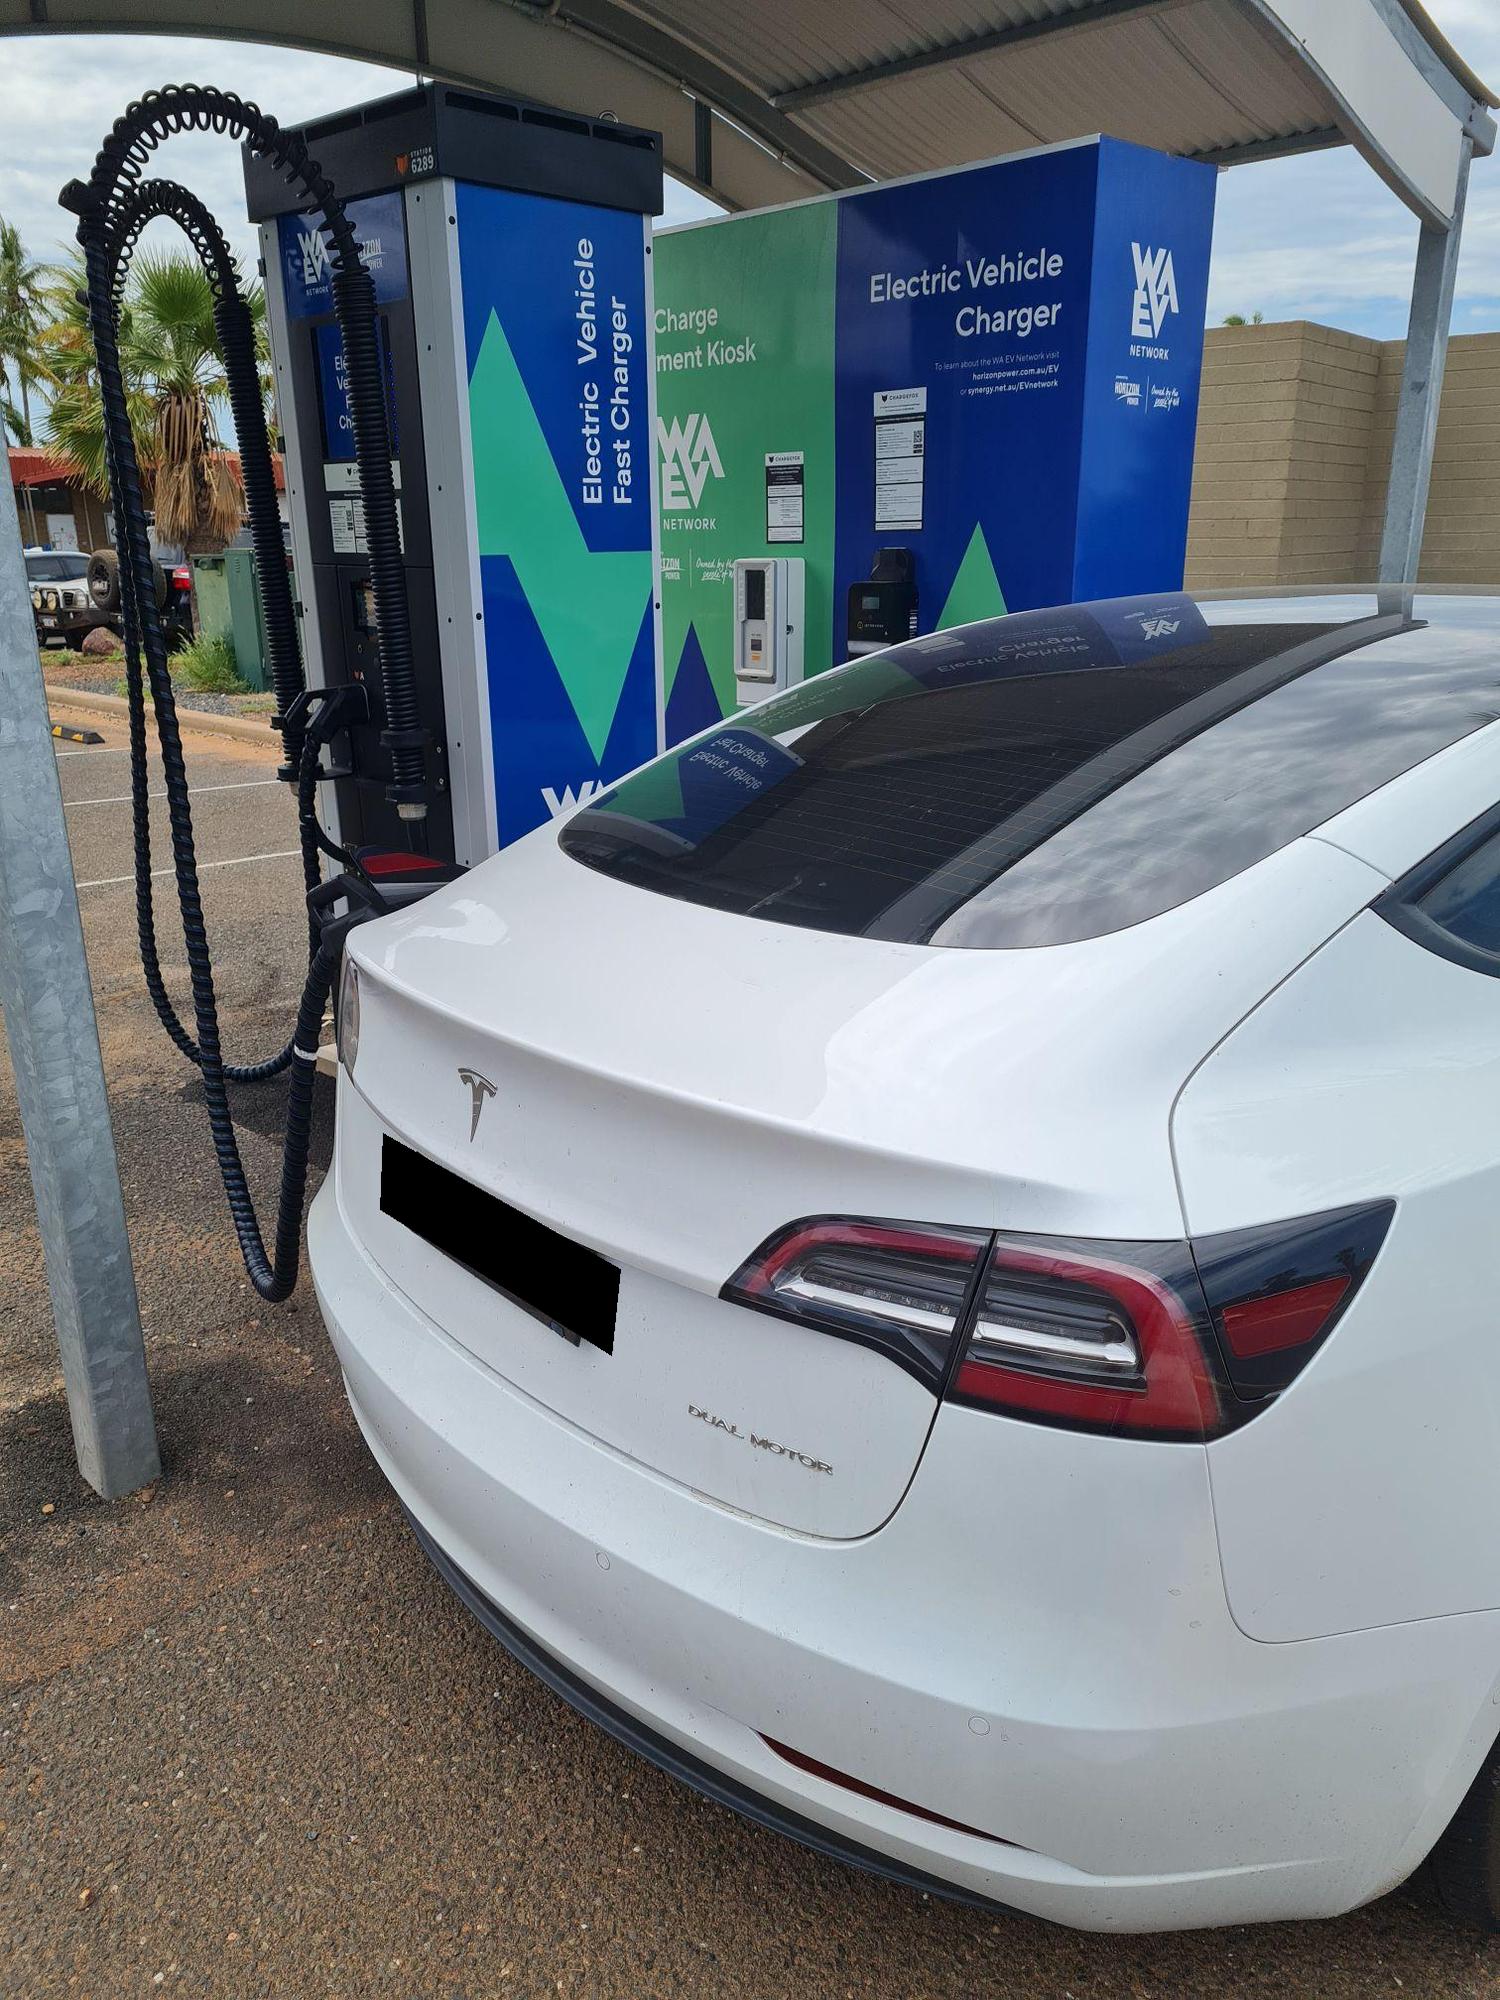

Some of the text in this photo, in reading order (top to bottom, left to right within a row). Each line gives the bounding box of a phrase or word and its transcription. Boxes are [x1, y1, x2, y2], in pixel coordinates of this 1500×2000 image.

[411, 154, 434, 173] 6289
[305, 285, 329, 296] NETWORK
[870, 247, 1064, 303] Electric Vehicle
[1131, 242, 1179, 313] WA
[655, 308, 718, 335] Charge
[955, 302, 1062, 337] Charger
[656, 336, 756, 372] ment Kiosk
[935, 350, 1060, 371] To learn about the WA EV Network visit
[1130, 344, 1169, 360] NETWORK
[573, 238, 602, 504] Electric Vehicle
[973, 363, 1060, 381] horizonpower.com.au/EV
[610, 295, 632, 504] Fast Charger
[968, 379, 1058, 396] synergy.net.au/EVnetwork
[663, 518, 717, 530] NETWORK
[541, 779, 604, 818] W
[688, 1403, 834, 1476] DUAL MOTOR
